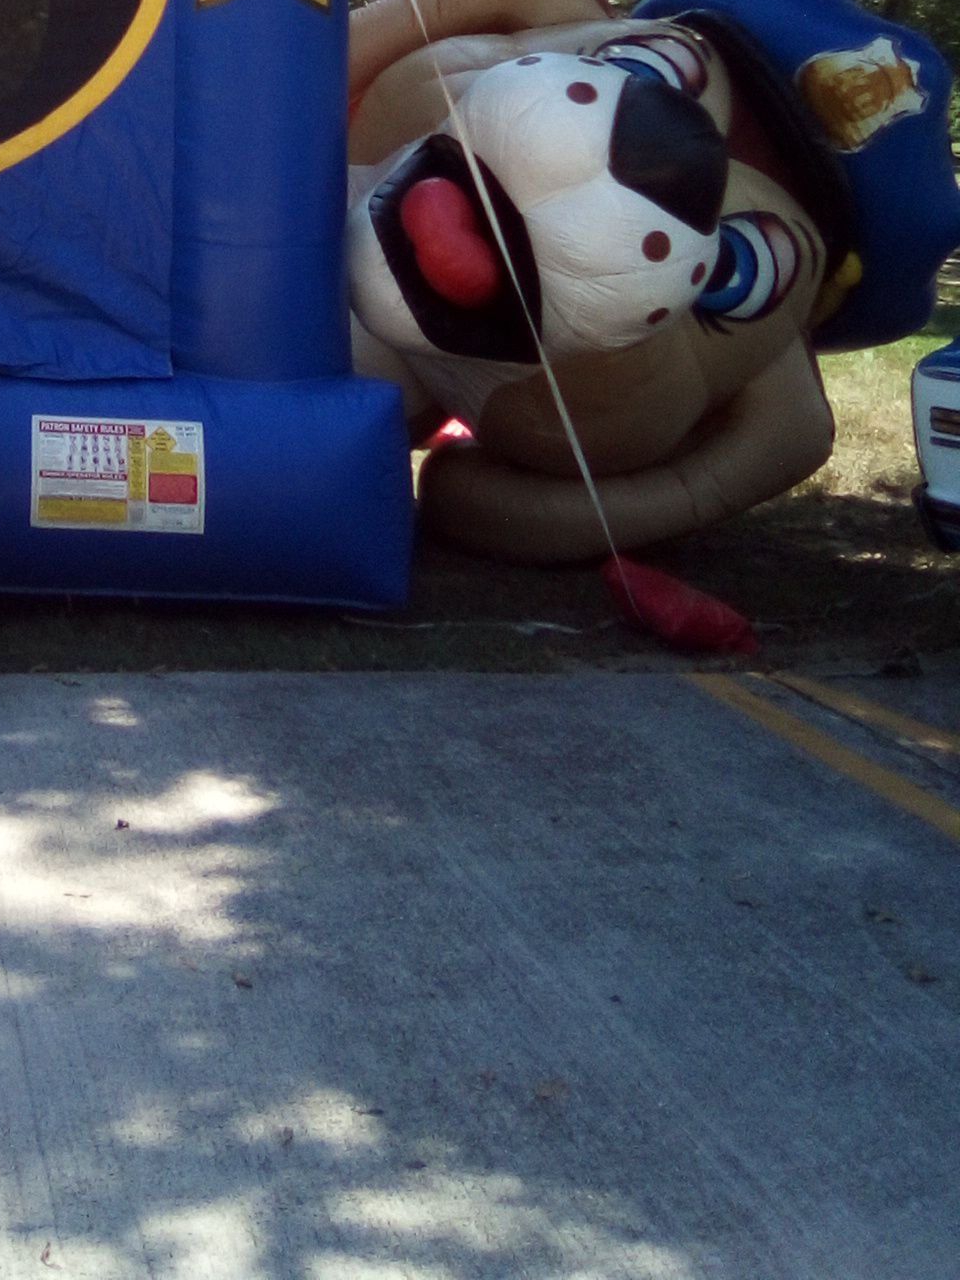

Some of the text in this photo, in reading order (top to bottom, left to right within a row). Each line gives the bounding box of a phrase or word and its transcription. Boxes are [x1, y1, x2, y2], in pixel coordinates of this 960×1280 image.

[40, 422, 70, 431] PATRON
[71, 423, 99, 433] SAFETY
[100, 425, 124, 434] RULES
